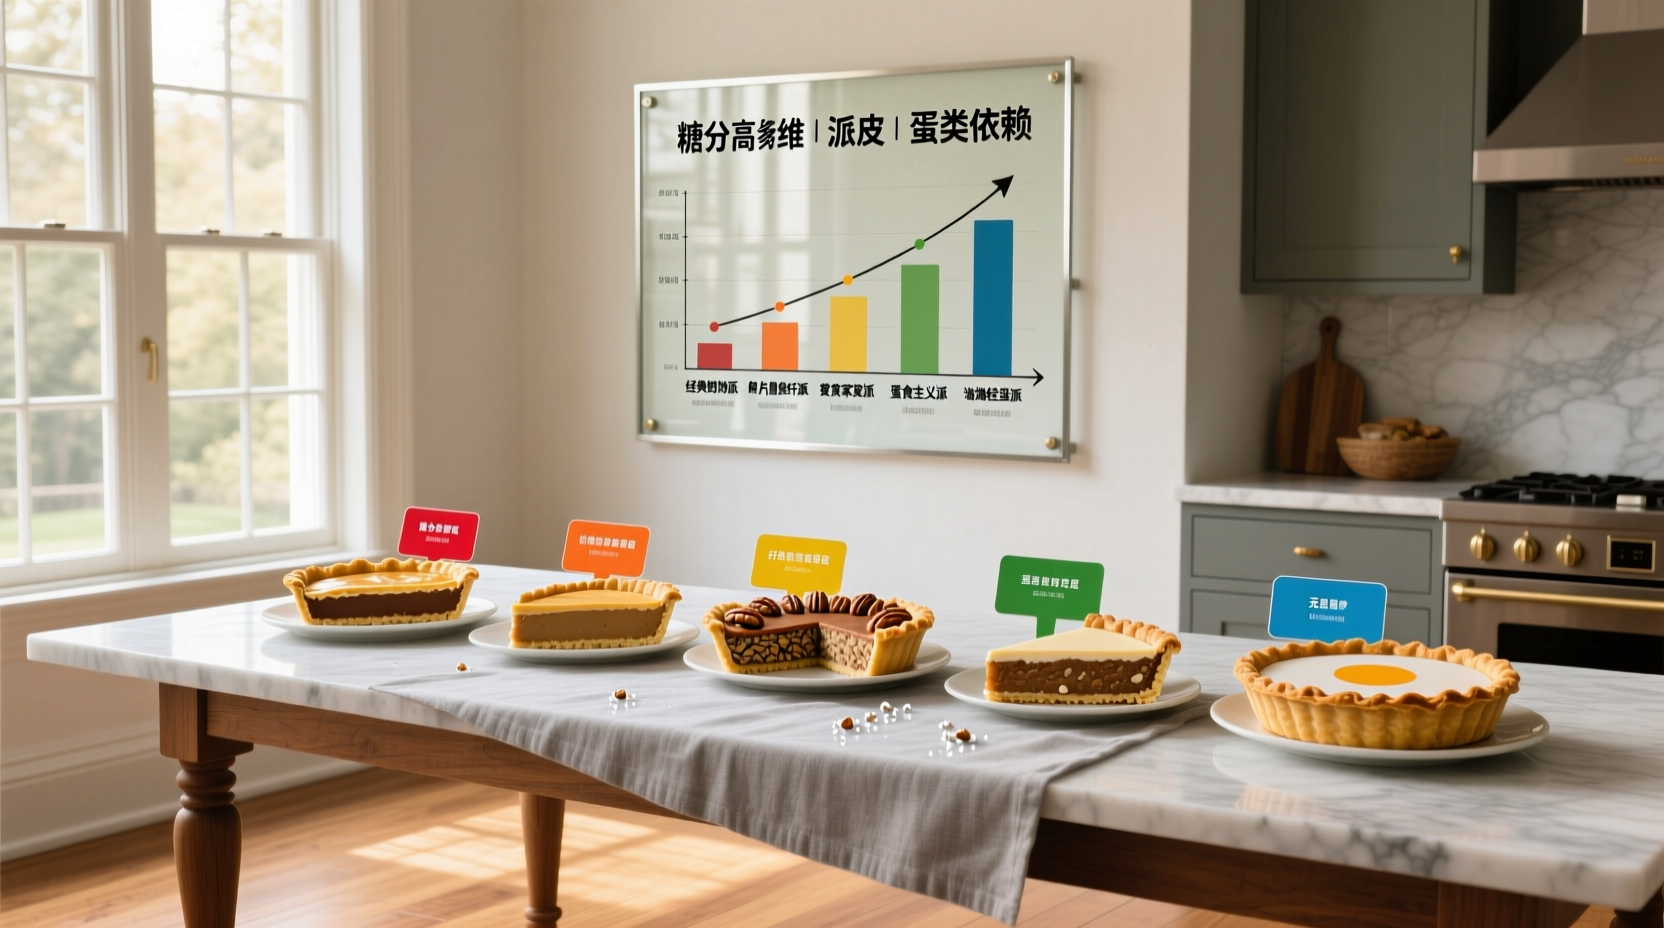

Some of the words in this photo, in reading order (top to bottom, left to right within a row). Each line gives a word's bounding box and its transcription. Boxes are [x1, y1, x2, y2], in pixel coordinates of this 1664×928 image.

[828, 113, 885, 148] 派皮
[910, 105, 1032, 144] 蛋类依赖
